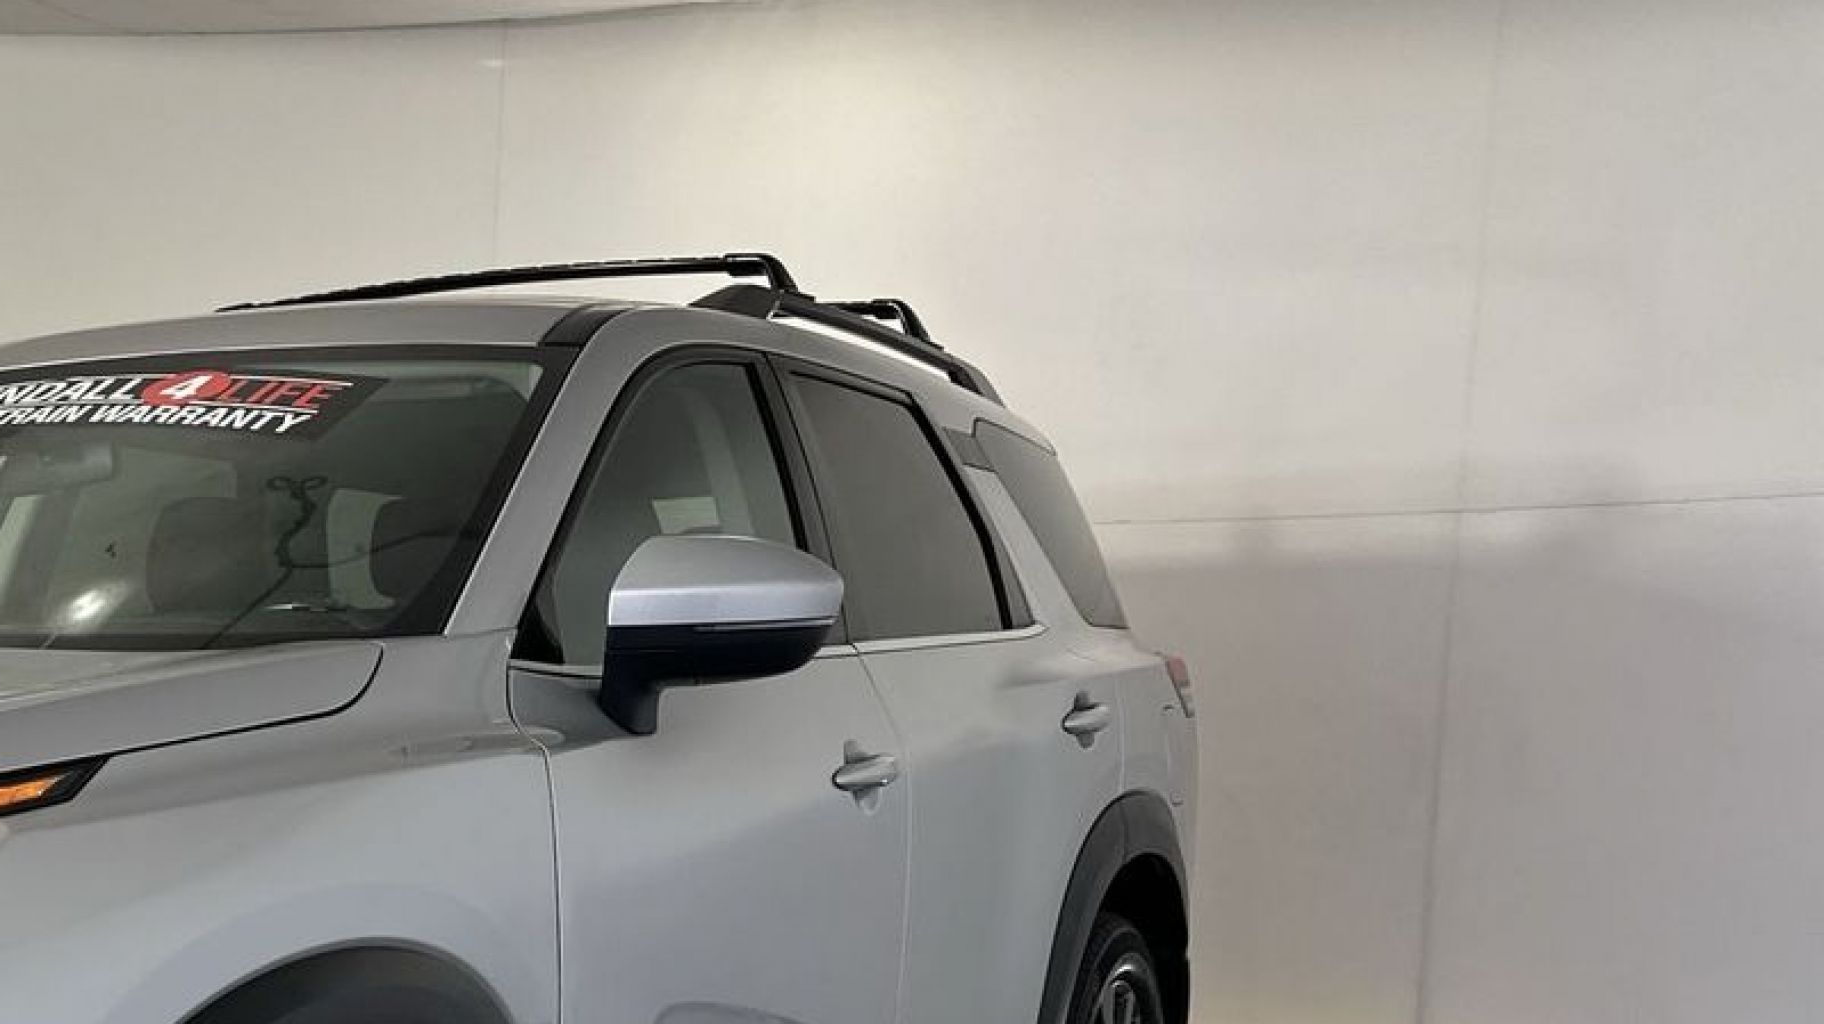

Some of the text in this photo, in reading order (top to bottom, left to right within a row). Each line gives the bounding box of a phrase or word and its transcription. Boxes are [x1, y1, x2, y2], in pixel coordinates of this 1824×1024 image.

[160, 375, 212, 400] 4
[217, 378, 344, 407] LIFE
[89, 405, 312, 433] WARRANTY
